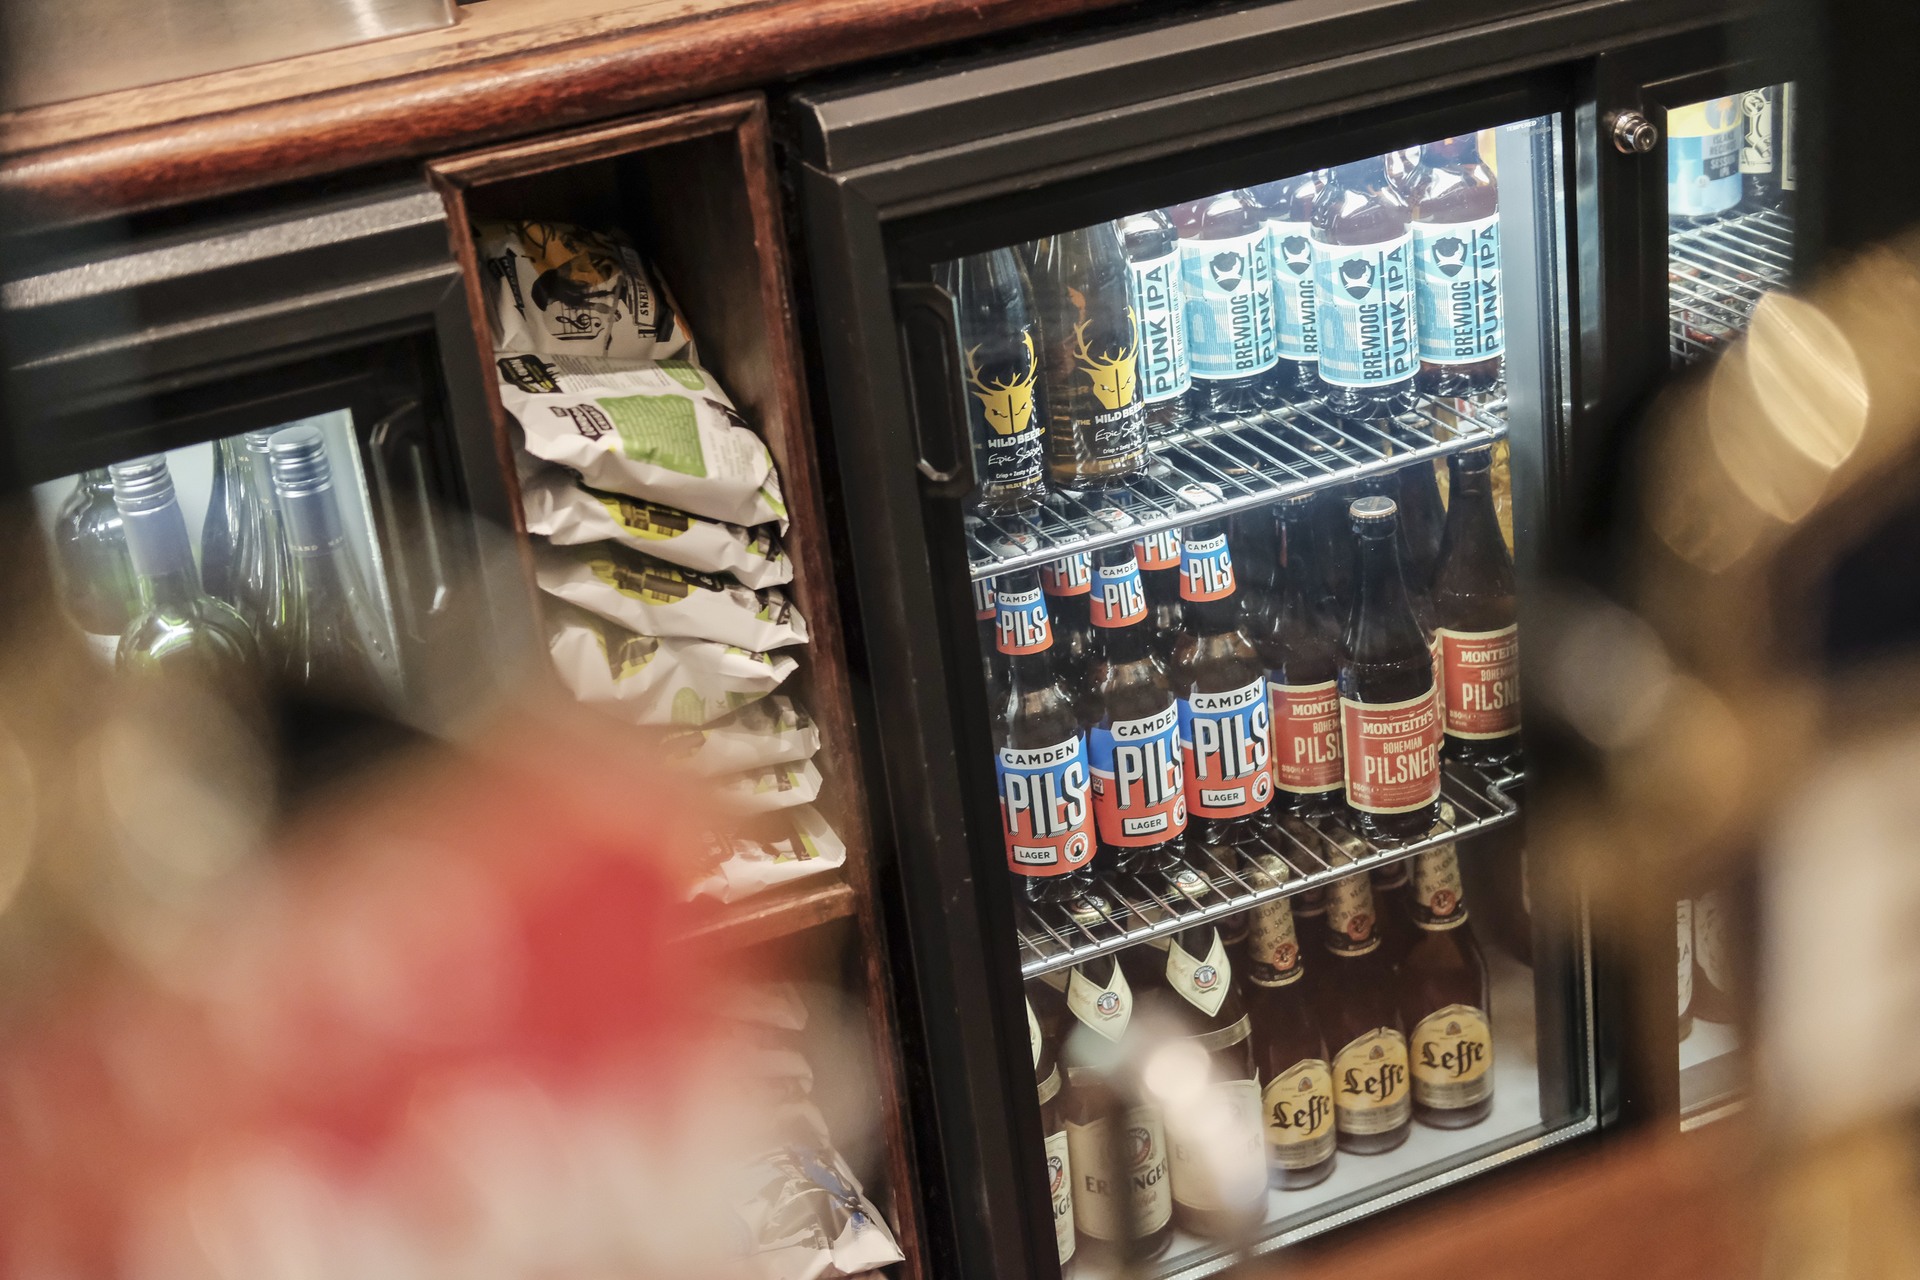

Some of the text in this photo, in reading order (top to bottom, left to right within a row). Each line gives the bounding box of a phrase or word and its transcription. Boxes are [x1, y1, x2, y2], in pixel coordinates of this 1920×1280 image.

[1254, 237, 1274, 364] PUNK IPA
[1479, 224, 1500, 352] PUNK IPA
[1387, 246, 1410, 375] PUNK IPA
[1452, 280, 1474, 357] BREWDOG
[1145, 266, 1172, 393] PUNK IPA
[1230, 294, 1254, 370] BREWDOG
[1358, 303, 1383, 380] BREWDOG
[1095, 411, 1122, 424] WILD
[1122, 401, 1142, 418] BEER
[988, 437, 1016, 449] WILD
[1016, 427, 1041, 445] BEER
[1095, 428, 1121, 442] Epic
[988, 453, 1015, 466] Epic
[1141, 504, 1176, 519] CAMEN
[1143, 528, 1181, 563] PILS
[1187, 537, 1225, 551] CAMDEN
[1189, 552, 1232, 594] PILS
[1000, 591, 1039, 604] CAMDEN
[1103, 582, 1145, 621] PILS
[1001, 606, 1046, 647] PILS
[1194, 686, 1261, 709] CAMDEN
[1292, 699, 1338, 716] MONTE
[1462, 677, 1521, 711] PILSN
[1117, 709, 1176, 737] CAMDEN
[1313, 719, 1340, 733] BOHEM
[1362, 708, 1434, 735] MONTEITH'S
[1004, 743, 1074, 766] CAMDEN
[1193, 701, 1269, 781] PILS
[1294, 733, 1342, 764] PILS
[1383, 736, 1423, 754] BOHEMIAN
[1114, 725, 1183, 810] PILS
[1364, 743, 1436, 785] PILSNER
[1004, 761, 1087, 839] PILS
[1207, 792, 1239, 802] LAGER
[1130, 817, 1162, 830] LAGER
[1019, 850, 1050, 861] LAGER
[1419, 1040, 1484, 1078] Leffe
[1341, 1063, 1405, 1102] Leffe
[1270, 1095, 1330, 1136] Leffe
[1085, 1158, 1167, 1197] ERNGER
